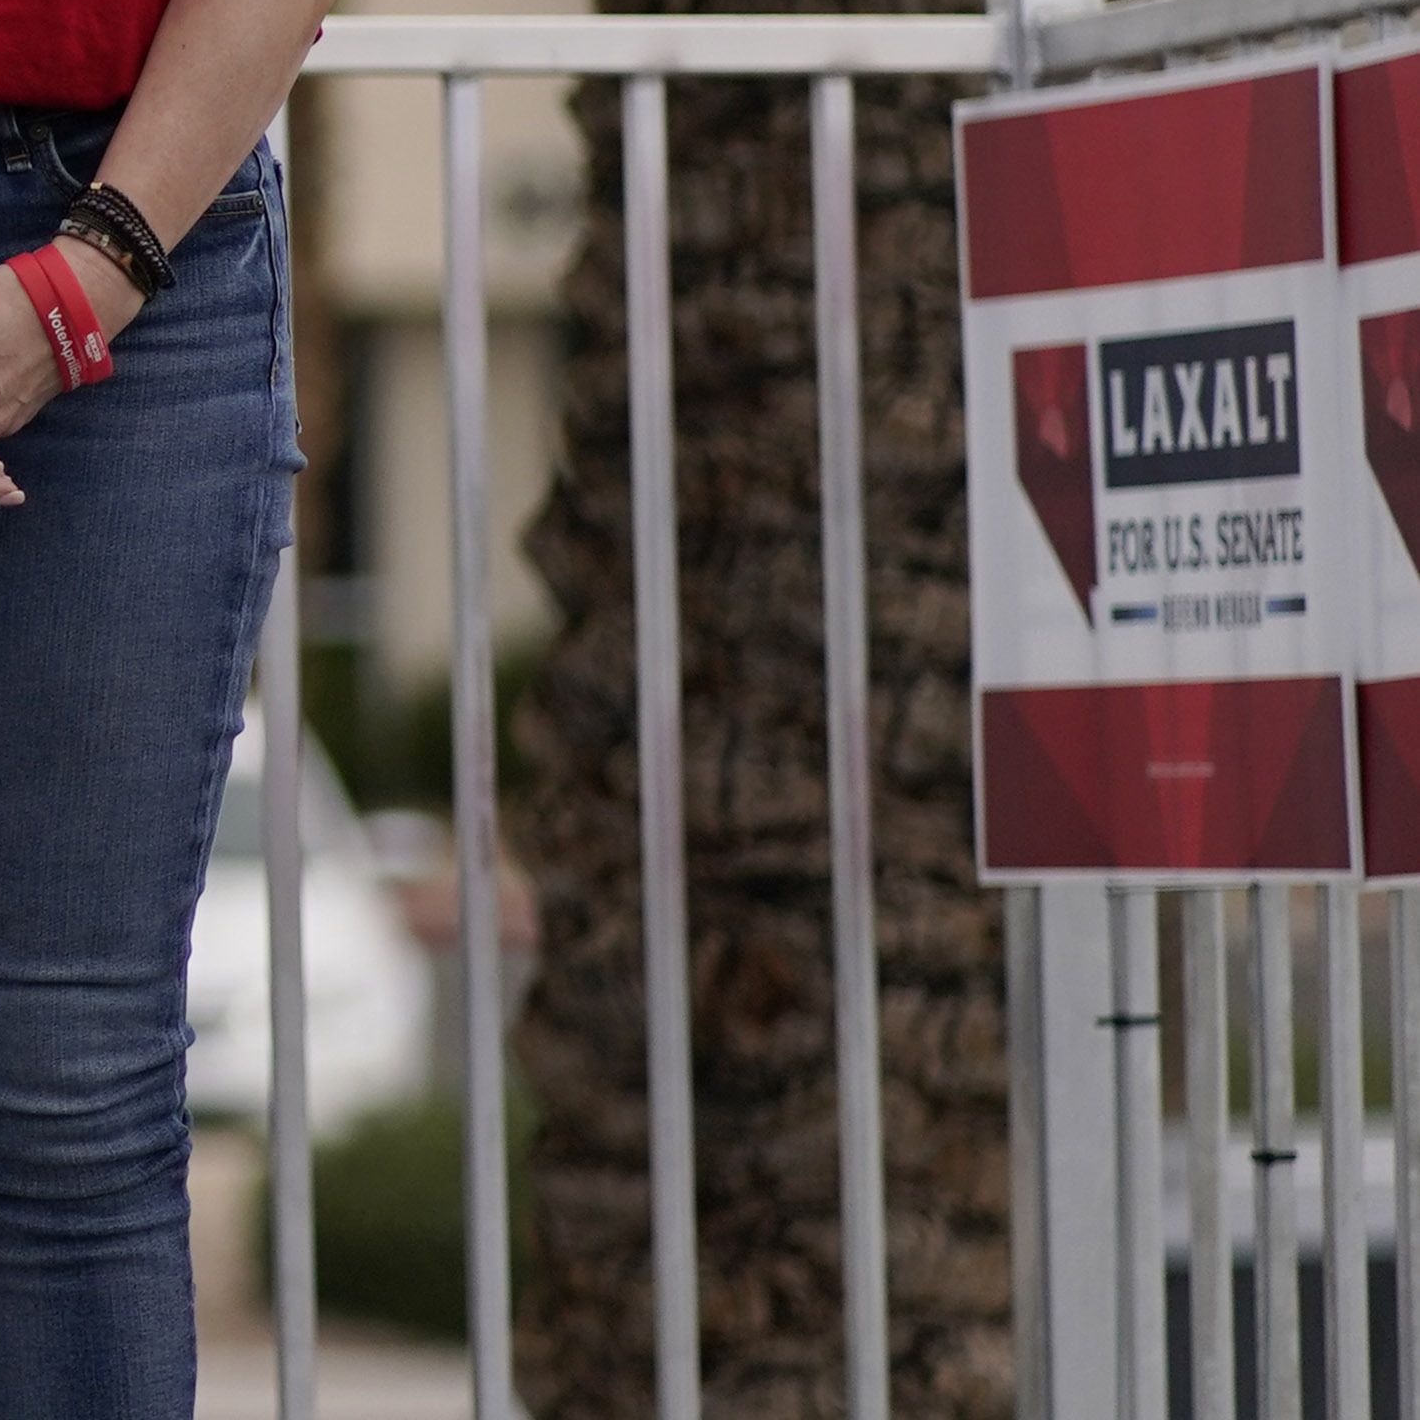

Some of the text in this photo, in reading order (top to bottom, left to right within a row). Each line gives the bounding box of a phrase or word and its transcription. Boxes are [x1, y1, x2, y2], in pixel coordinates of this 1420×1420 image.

[1109, 352, 1292, 458] LAXALT
[1108, 516, 1158, 574] FOR
[1215, 506, 1304, 567] SENATE
